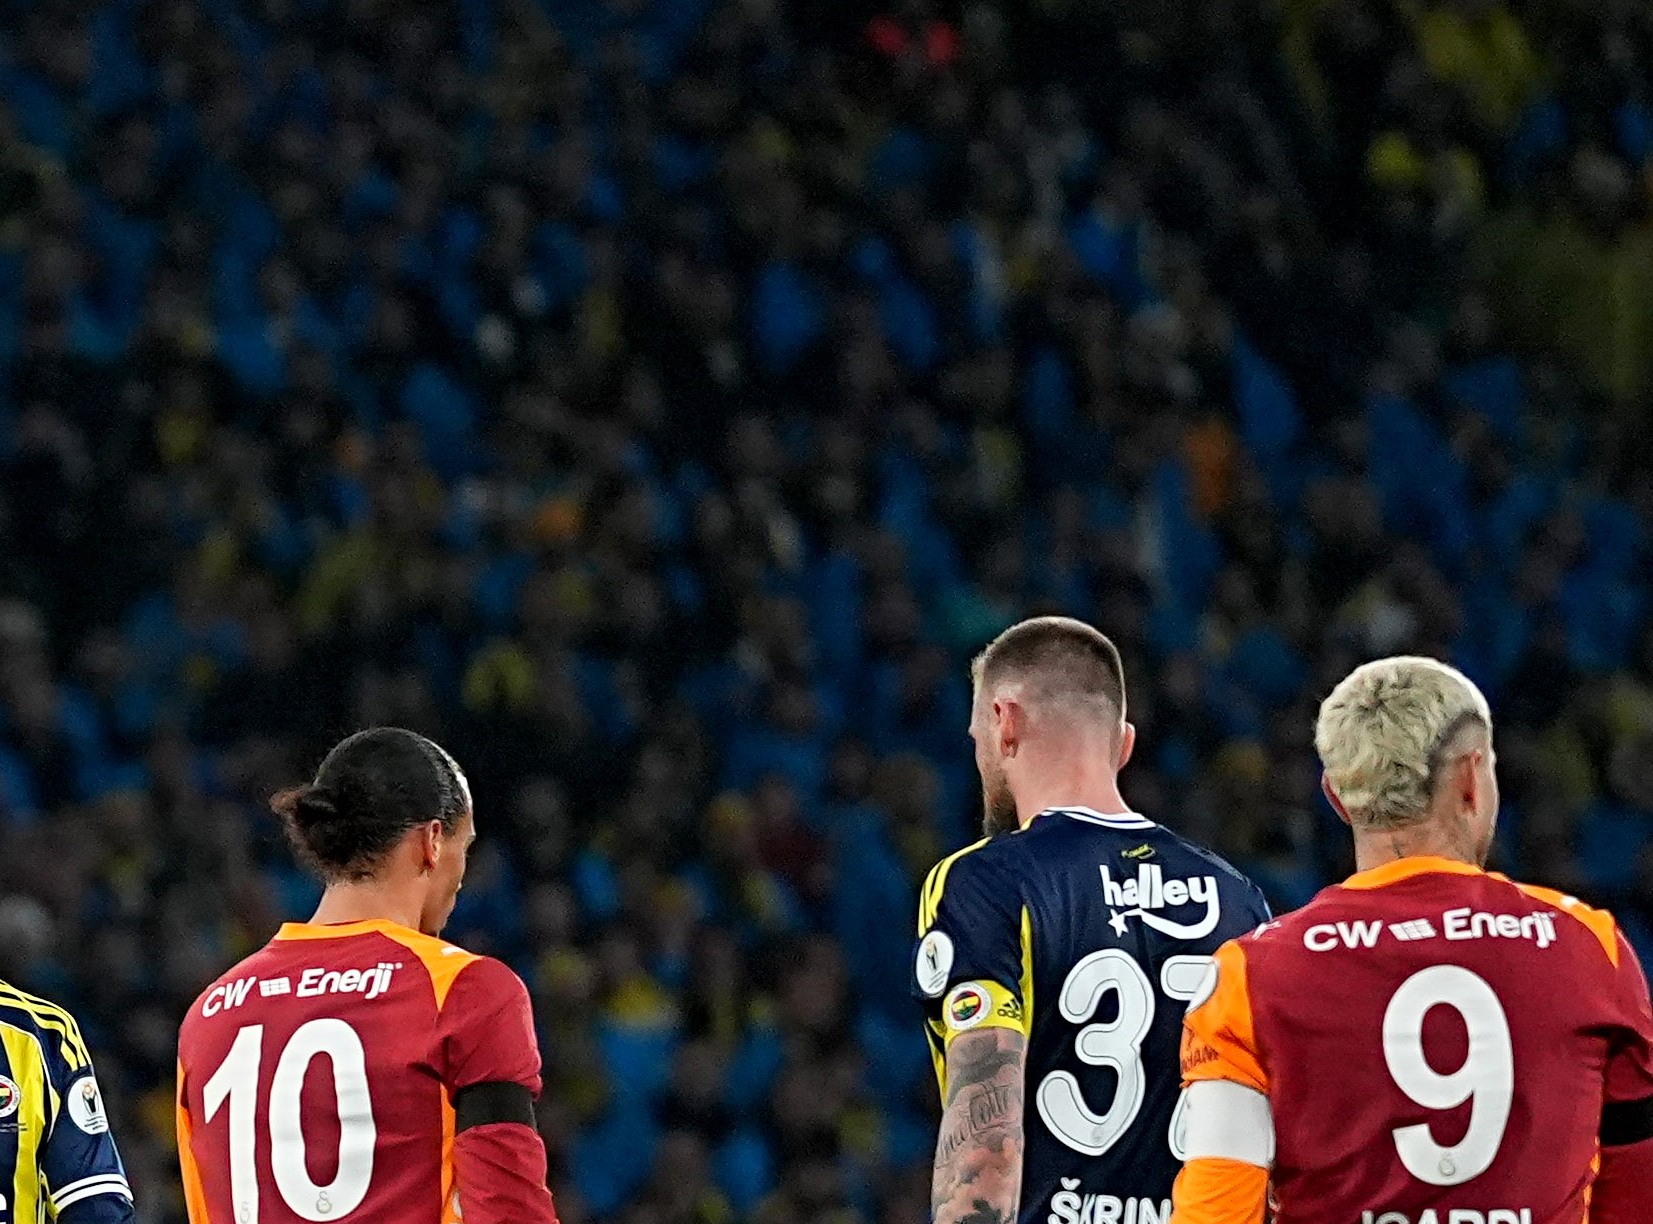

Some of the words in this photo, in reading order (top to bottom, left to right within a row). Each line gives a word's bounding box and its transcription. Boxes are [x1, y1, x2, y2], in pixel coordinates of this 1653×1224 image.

[1099, 863, 1220, 940] halley
[1303, 919, 1383, 953] CW
[1443, 907, 1556, 949] Enerji
[201, 976, 257, 1018] CW
[296, 962, 396, 1000] Enerji
[1382, 964, 1515, 1187] 9
